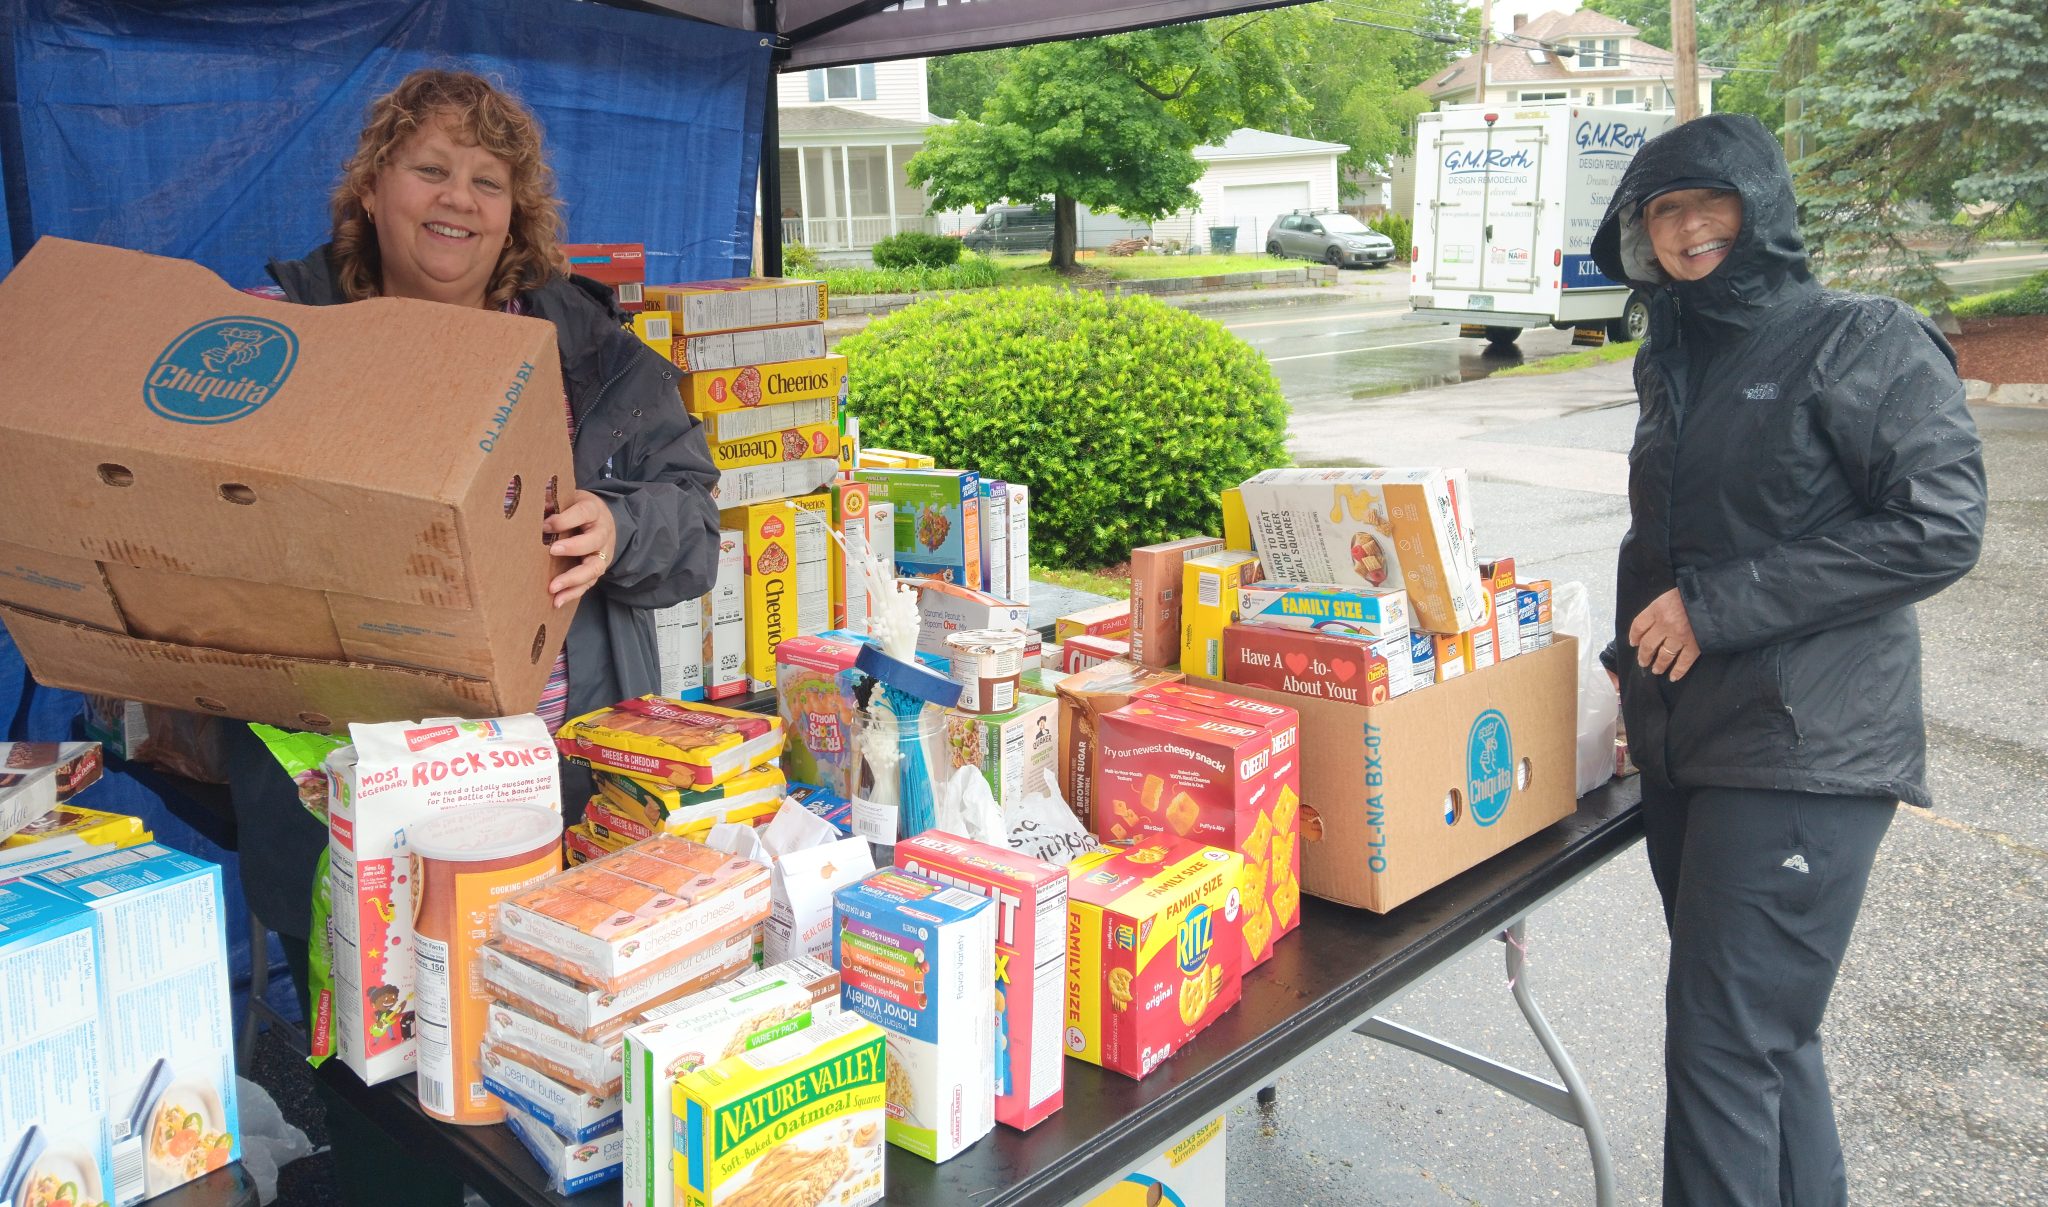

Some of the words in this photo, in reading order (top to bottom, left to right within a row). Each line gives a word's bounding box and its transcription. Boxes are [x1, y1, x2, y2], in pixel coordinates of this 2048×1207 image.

[1448, 176, 1476, 184] DESIGN
[1477, 176, 1528, 184] REMODELING
[1590, 192, 1611, 205] Since
[1508, 252, 1528, 260] NAHB
[818, 284, 827, 319] Cheerios
[149, 363, 273, 406] Chiquita
[767, 372, 829, 395] Cheerios
[718, 439, 777, 462] Cheerios
[962, 480, 978, 492] FROSTED
[1260, 509, 1274, 535] BEAT
[1271, 512, 1288, 550] QUAKER
[1280, 510, 1300, 555] SQUARES
[1268, 537, 1278, 550] TO
[1272, 553, 1287, 578] HARD
[1281, 551, 1292, 563] OF
[765, 578, 785, 656] Cheerios
[1281, 597, 1330, 617] FAMILY
[1333, 599, 1363, 619] SIZE
[943, 620, 957, 631] Chex
[1102, 617, 1129, 631] FAMILY
[1241, 648, 1271, 667] Have
[1273, 652, 1283, 669] A
[1309, 659, 1332, 675] -to-
[1283, 676, 1322, 696] About
[1324, 681, 1358, 701] Your
[810, 713, 837, 723] WORLD
[1225, 699, 1285, 715] CHEEZ-IT
[410, 727, 454, 744] cinnamon
[810, 722, 838, 737] LOOPS
[1195, 721, 1257, 737] CHEEZ-IT
[810, 737, 841, 751] FROOT
[1033, 735, 1052, 749] QUAKER
[411, 752, 487, 788] ROCK
[488, 746, 553, 769] SONG
[601, 748, 624, 761] CHEESE
[630, 755, 660, 769] CHEDDAR
[1077, 741, 1087, 773] SUGAR
[1104, 746, 1118, 759] Try
[1117, 747, 1133, 757] our
[1132, 744, 1163, 756] newest
[1163, 743, 1195, 760] cheesy
[1195, 751, 1226, 773] snack!
[1240, 748, 1270, 781] CHEEZ-IT
[1363, 722, 1385, 789] BX-07
[361, 766, 399, 787] MOST
[443, 788, 462, 796] need
[471, 782, 500, 794] totally
[501, 778, 535, 790] awesome
[536, 775, 552, 786] song
[1469, 766, 1512, 806] Chiquita
[357, 779, 408, 800] LEGENDARY
[427, 798, 440, 807] for
[442, 795, 456, 804] the
[485, 792, 496, 801] of
[497, 789, 510, 798] the
[1077, 774, 1086, 808] BROWN
[609, 815, 628, 830] CHEESE
[633, 822, 651, 837] PEANUT
[1035, 882, 1053, 895] Nutrition
[1053, 877, 1068, 888] Facts
[1147, 873, 1184, 898] FAMILY
[1182, 861, 1209, 879] SIZE
[1166, 887, 1201, 920] FAMILY
[1203, 873, 1223, 897] SIZE
[1229, 893, 1235, 907] 6
[644, 927, 683, 951] cheese
[684, 917, 698, 931] on
[700, 899, 736, 925] cheese
[802, 928, 817, 943] REAL
[861, 928, 879, 941] Spice
[1176, 904, 1214, 969] RITZ
[525, 920, 553, 941] cheese
[553, 935, 564, 944] on
[565, 939, 595, 956] cheese
[885, 936, 900, 948] Raisin
[1069, 911, 1081, 980] FAMILY
[1119, 923, 1133, 951] RITZ
[956, 934, 966, 969] Variety
[431, 961, 445, 972] 150
[622, 973, 655, 998] toasty
[657, 958, 693, 984] peanut
[694, 943, 723, 964] butter
[859, 981, 877, 994] Flavor
[878, 988, 900, 1003] Regular
[956, 969, 965, 1000] Flavor
[1153, 981, 1164, 992] the
[845, 984, 882, 1014] Variety
[1069, 983, 1080, 1022] SIZE
[1145, 985, 1174, 1012] original
[853, 1005, 884, 1023] Oatmeal
[883, 1003, 918, 1028] Flavor
[883, 1015, 908, 1032] Instant
[751, 1029, 780, 1046] VARIETY
[781, 1021, 799, 1034] PACK
[1074, 1034, 1083, 1045] 6
[624, 1049, 632, 1068] PACK
[668, 1053, 701, 1072] Hannaford
[504, 1064, 537, 1088] peanut
[538, 1079, 566, 1105] butter
[624, 1069, 632, 1101] VARIETY
[720, 1071, 809, 1153] NATURE
[808, 1041, 883, 1094] VALLEY
[953, 1088, 961, 1114] BASKET
[720, 1134, 772, 1176] Soft-Baked
[773, 1092, 851, 1141] Oatmeal
[852, 1094, 881, 1108] Squares
[953, 1113, 961, 1144] MARKET
[1196, 1119, 1218, 1138] CLASS
[1196, 1124, 1220, 1146] SELECTED
[876, 1143, 882, 1156] 6
[1172, 1133, 1196, 1156] EXTRA
[1174, 1142, 1196, 1164] QUALITY
[624, 1127, 635, 1189] chewy
